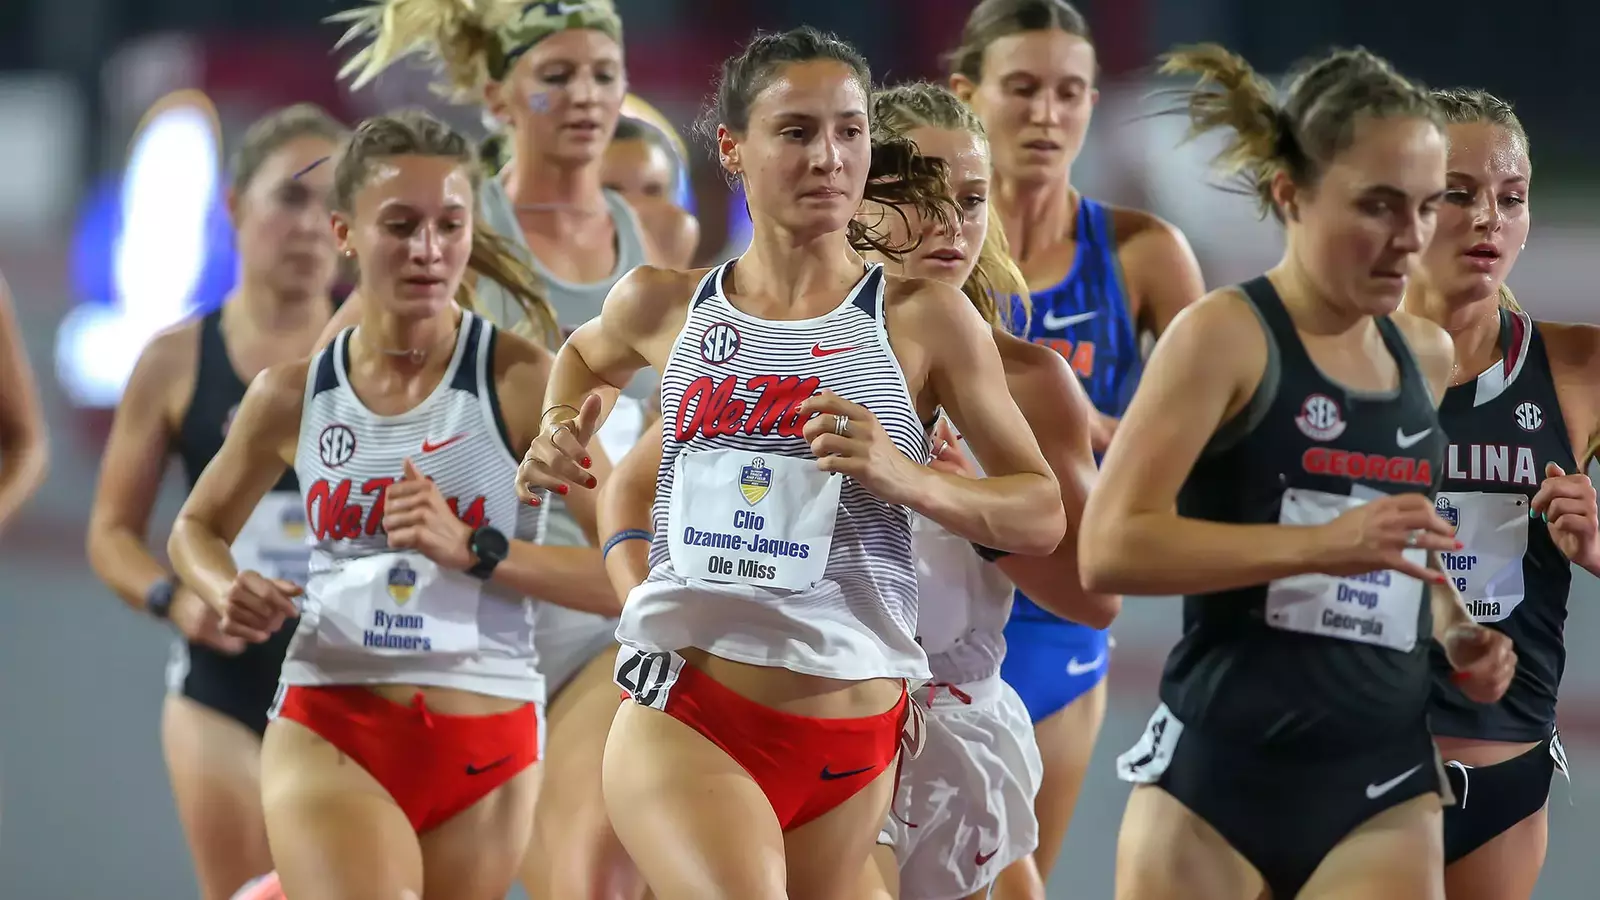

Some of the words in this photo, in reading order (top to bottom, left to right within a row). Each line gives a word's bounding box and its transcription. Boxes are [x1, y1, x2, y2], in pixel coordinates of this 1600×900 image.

[703, 325, 737, 362] SEC
[675, 375, 746, 442] Ole
[1306, 397, 1337, 429] SEC
[1515, 402, 1543, 430] SEC
[320, 426, 355, 466] SEC
[1302, 447, 1432, 486] GEORGIA
[307, 477, 363, 541] Ole
[733, 509, 765, 531] Clio
[683, 526, 810, 559] Ozanne-Jaques
[708, 555, 733, 575] Ole
[737, 559, 776, 580] Miss
[1336, 582, 1379, 610] Drop
[374, 609, 424, 630] Ryann
[1322, 608, 1383, 636] Georgia
[363, 630, 431, 651] Helmers
